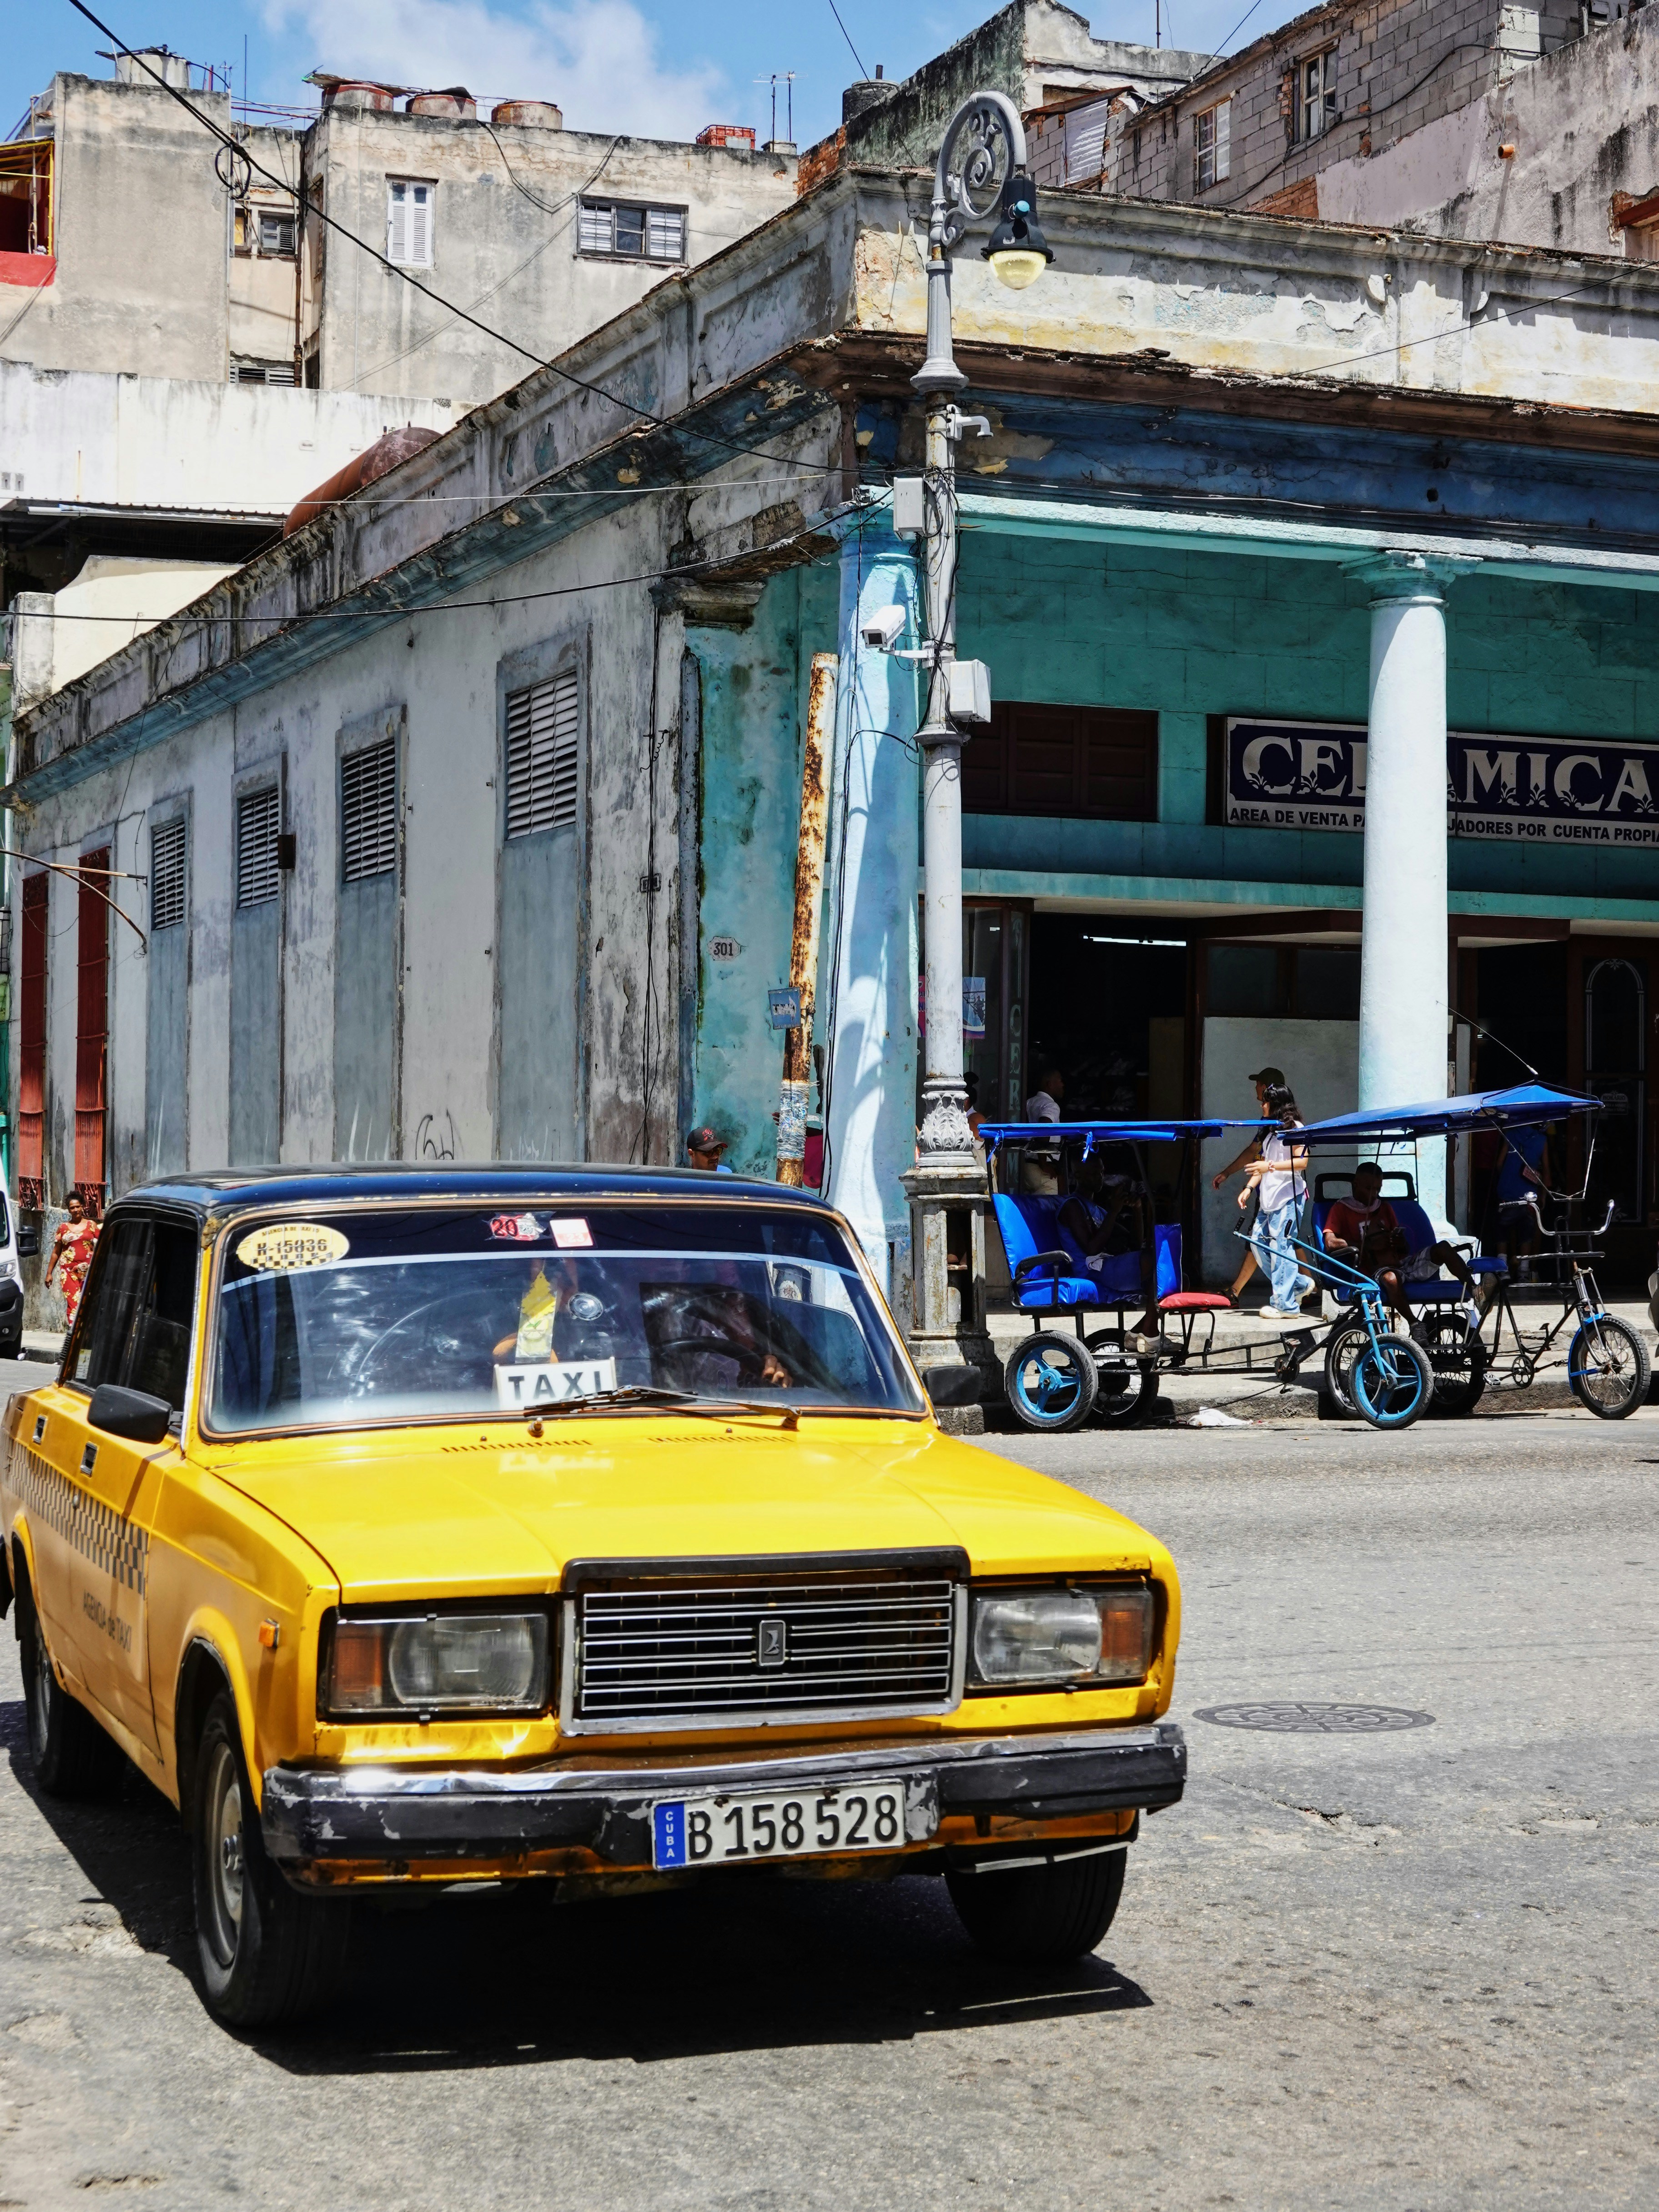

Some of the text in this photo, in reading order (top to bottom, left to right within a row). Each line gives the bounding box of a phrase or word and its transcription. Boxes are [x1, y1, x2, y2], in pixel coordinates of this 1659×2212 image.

[1242, 735, 1659, 814] CEMICA
[1230, 807, 1270, 823] AREA
[1275, 810, 1294, 824] DE
[1299, 811, 1349, 827] VENTA
[1448, 819, 1513, 835] JADORES
[1517, 823, 1547, 837] POR
[1553, 824, 1610, 840] CUENTA
[714, 942, 734, 956] 301
[492, 1218, 518, 1237] 20
[508, 1371, 602, 1401] TAXI
[664, 1811, 675, 1859] CUBA
[688, 1794, 898, 1861] B 158 528
